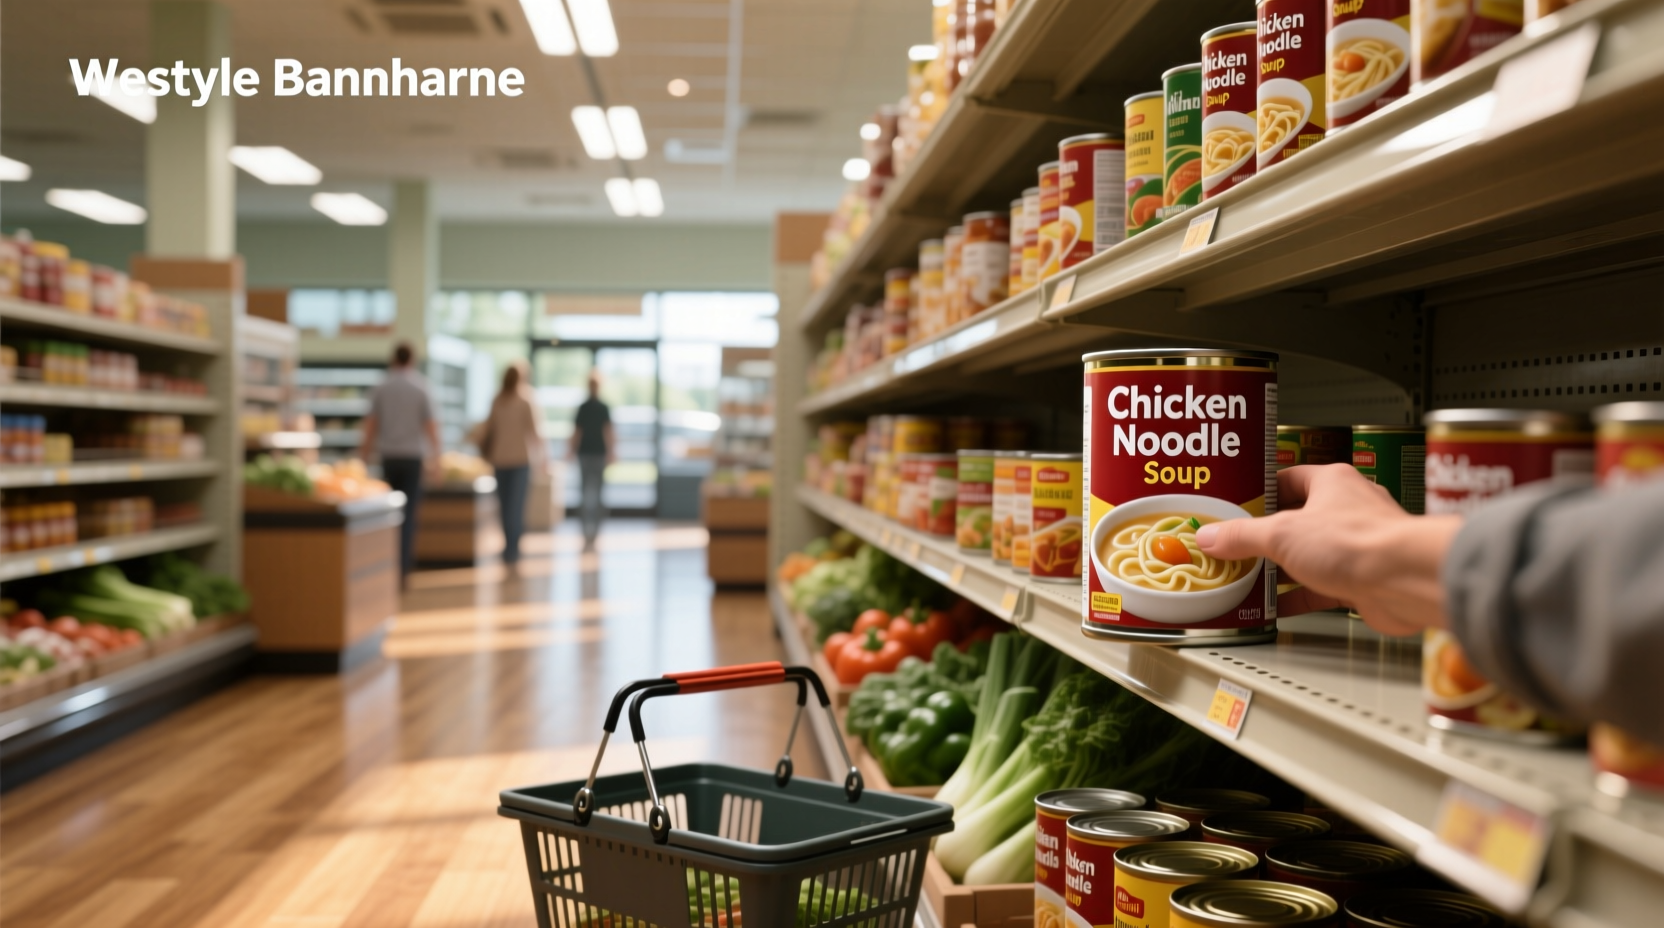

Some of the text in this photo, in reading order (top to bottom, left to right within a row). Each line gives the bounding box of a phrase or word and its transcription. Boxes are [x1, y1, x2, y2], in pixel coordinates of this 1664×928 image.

[1108, 385, 1247, 419] Chicken
[1113, 423, 1241, 457] Noodle
[1144, 461, 1211, 489] Soup
